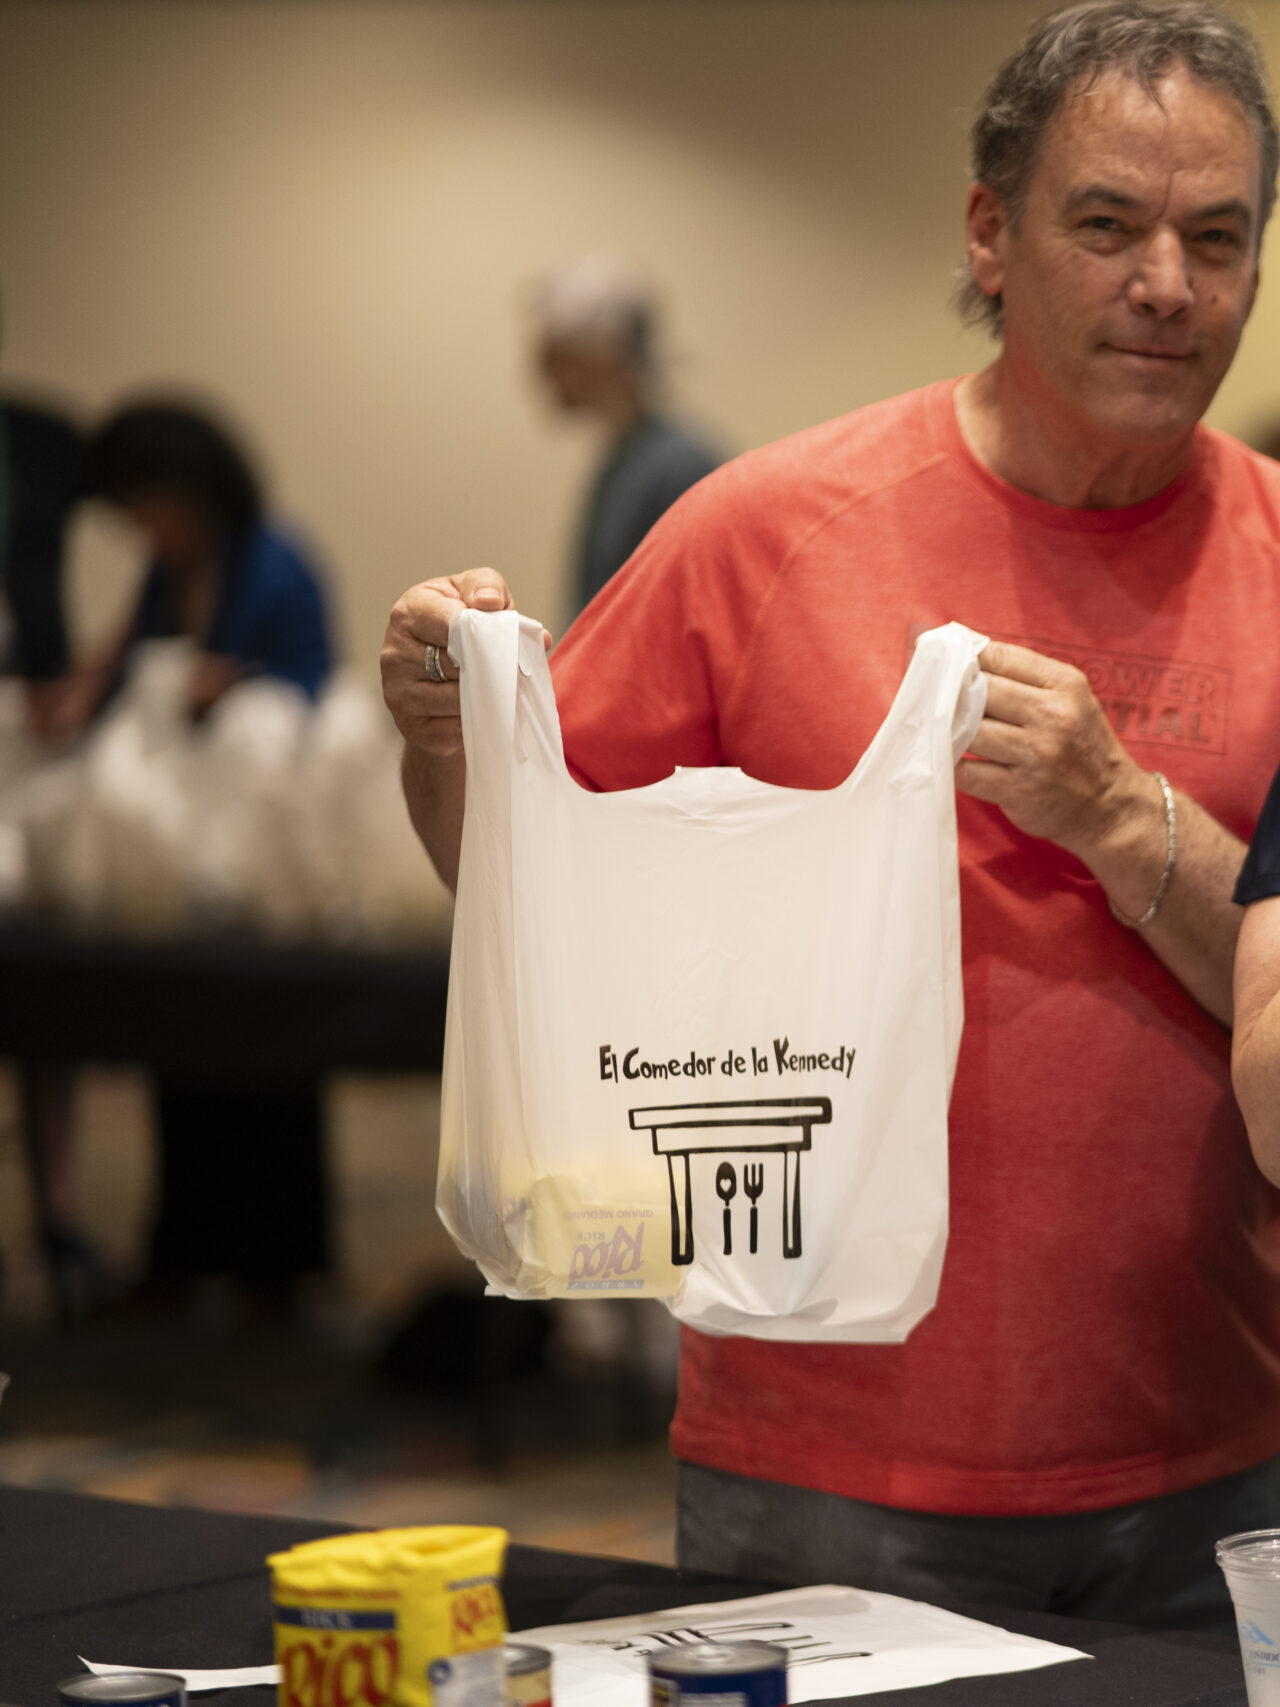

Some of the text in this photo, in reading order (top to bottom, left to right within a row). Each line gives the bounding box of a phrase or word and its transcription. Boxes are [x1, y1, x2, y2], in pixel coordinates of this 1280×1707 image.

[1081, 657, 1217, 704] OWER
[599, 1035, 857, 1084] El Comedor de la Kennedy
